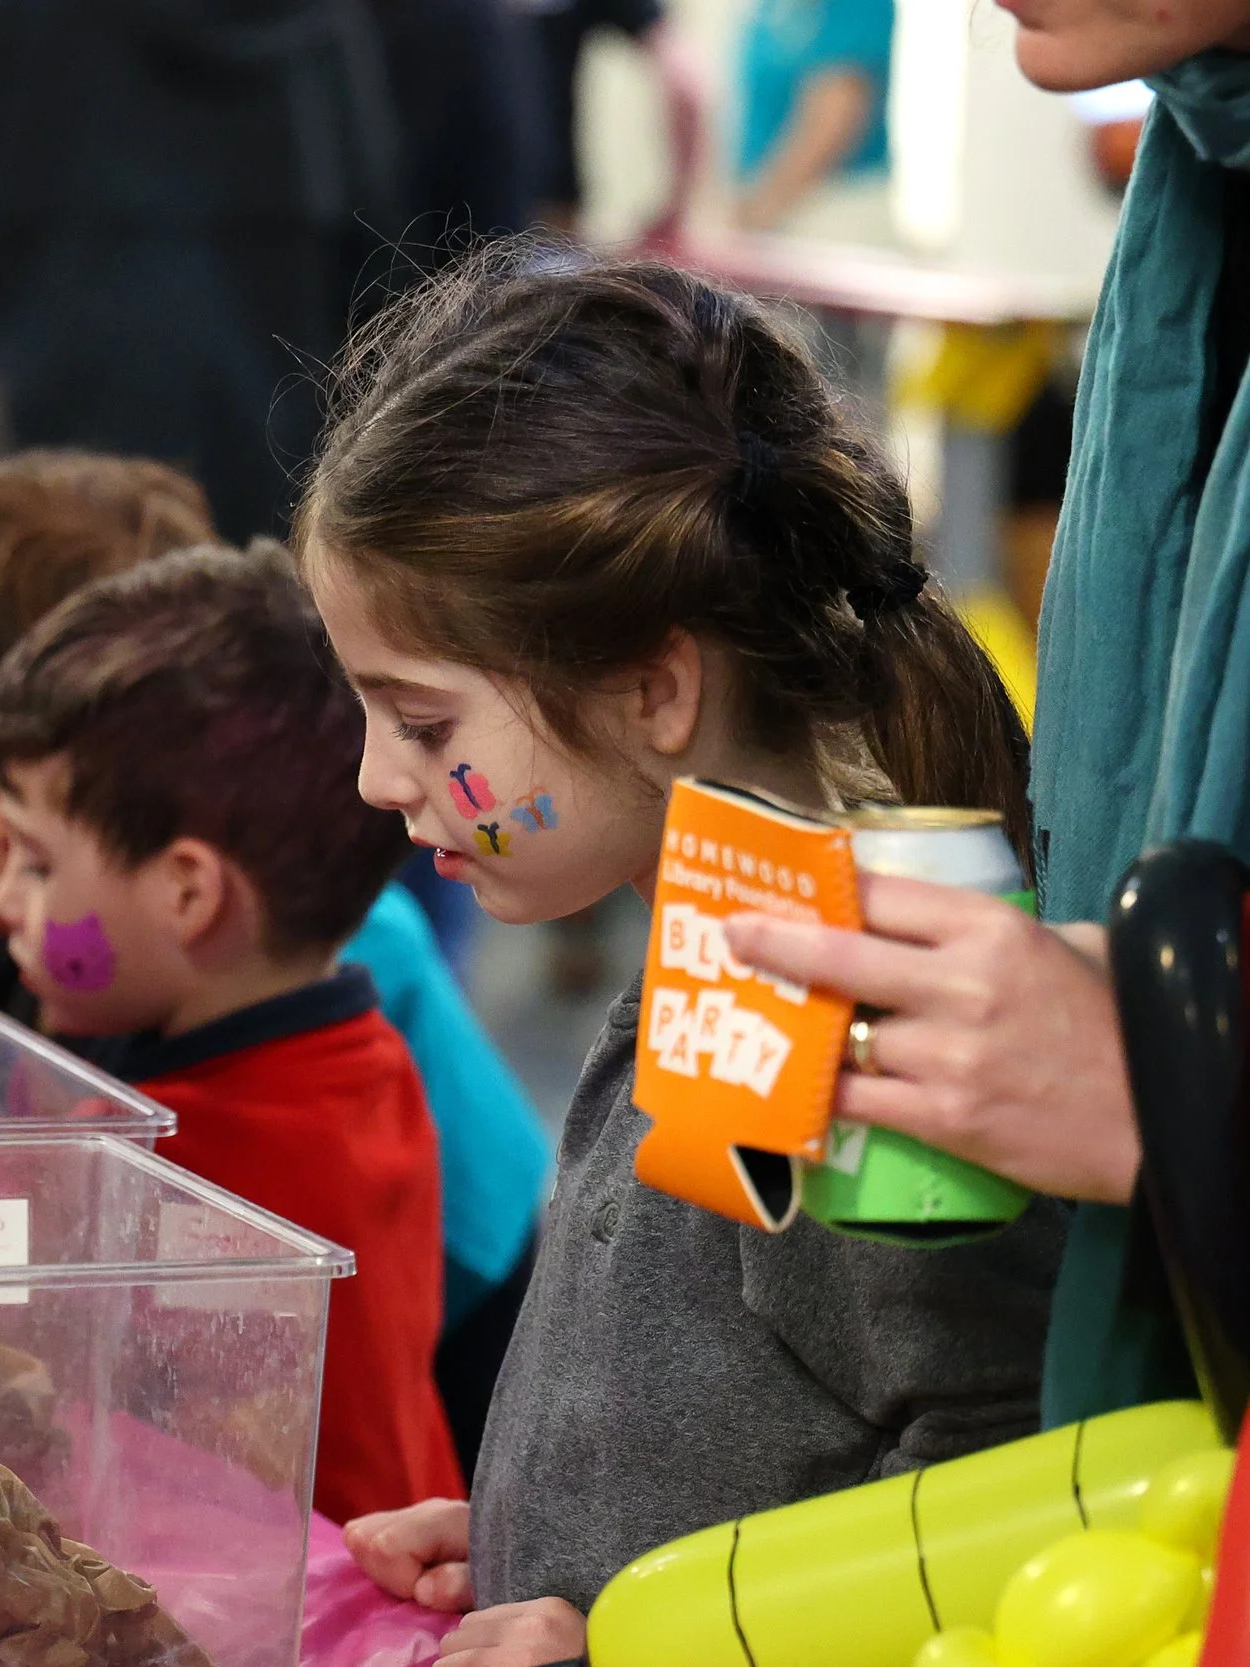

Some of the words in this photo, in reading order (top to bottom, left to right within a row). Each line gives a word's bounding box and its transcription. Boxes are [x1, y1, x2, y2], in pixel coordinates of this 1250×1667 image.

[662, 858, 723, 901] Library
[666, 828, 817, 899] HOMEWOOD
[655, 1000, 780, 1077] PARTY
